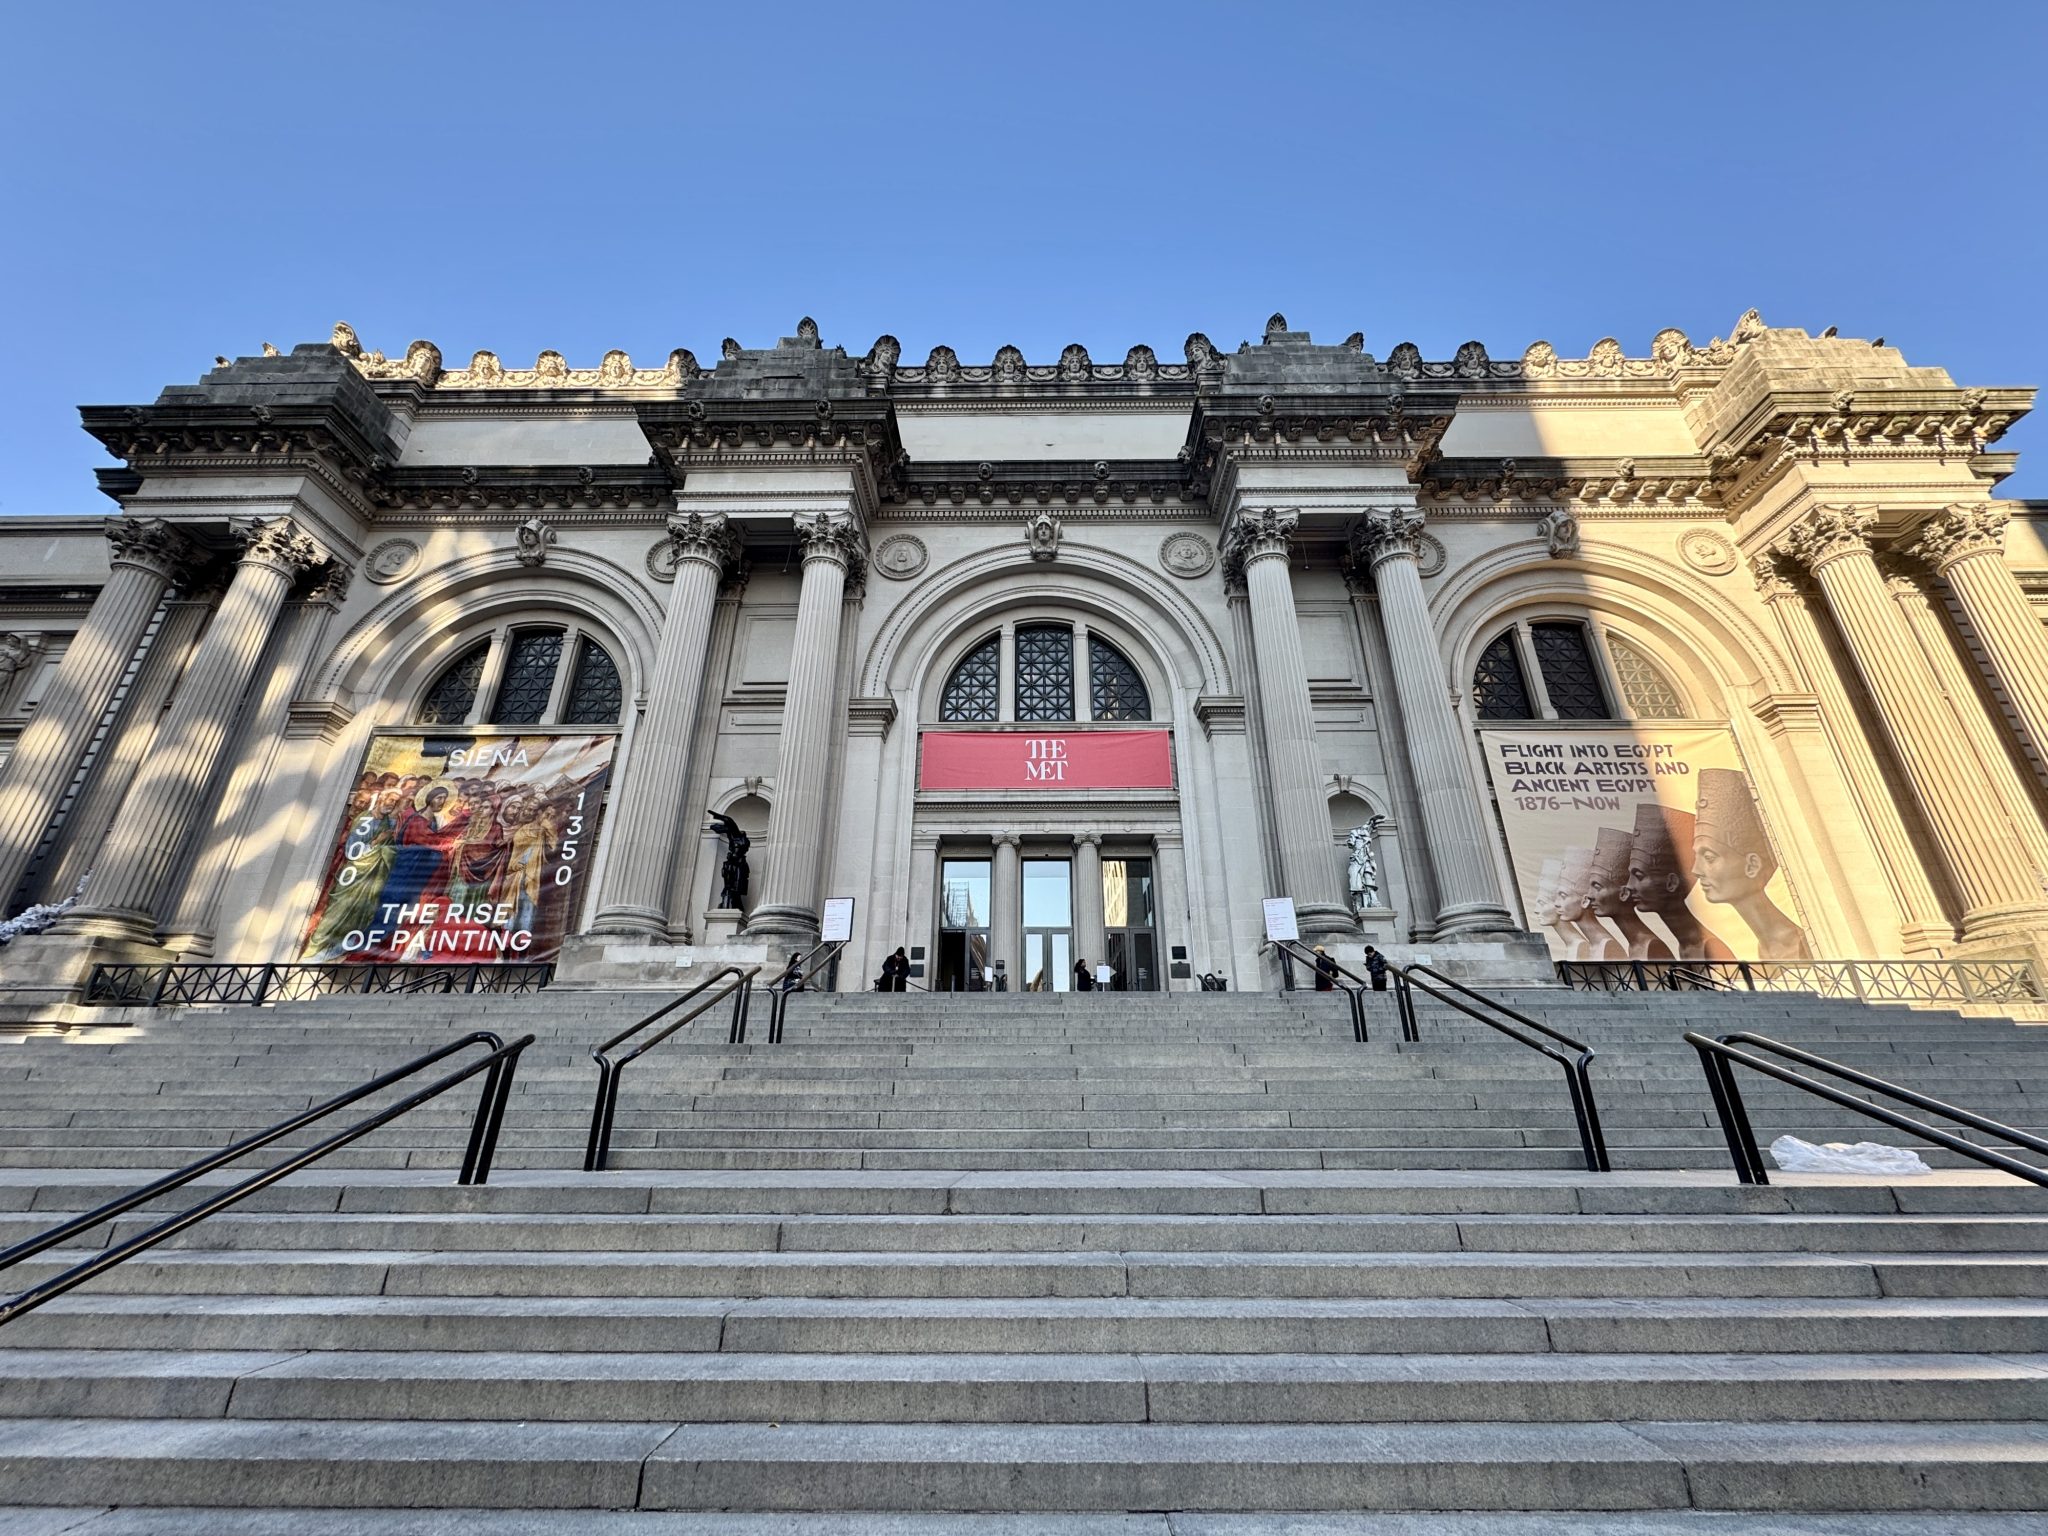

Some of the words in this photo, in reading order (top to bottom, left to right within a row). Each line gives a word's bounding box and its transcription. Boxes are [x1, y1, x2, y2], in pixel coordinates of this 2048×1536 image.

[448, 749, 529, 767] SIENA
[1025, 739, 1067, 759] THE
[1500, 744, 1563, 758] FLIGHT
[1570, 744, 1609, 758] INTO
[1614, 744, 1673, 759] EGYPT
[1024, 761, 1068, 780] MET
[1505, 762, 1567, 775] BLACK
[1573, 762, 1648, 775] ARTISTS
[1655, 762, 1690, 775] AND
[1511, 779, 1590, 793] ANCIENT
[1597, 779, 1657, 793] EGYPT
[381, 903, 437, 925] THE
[444, 903, 513, 925] RISE
[341, 930, 385, 952] OF
[391, 929, 532, 952] PAINTING
